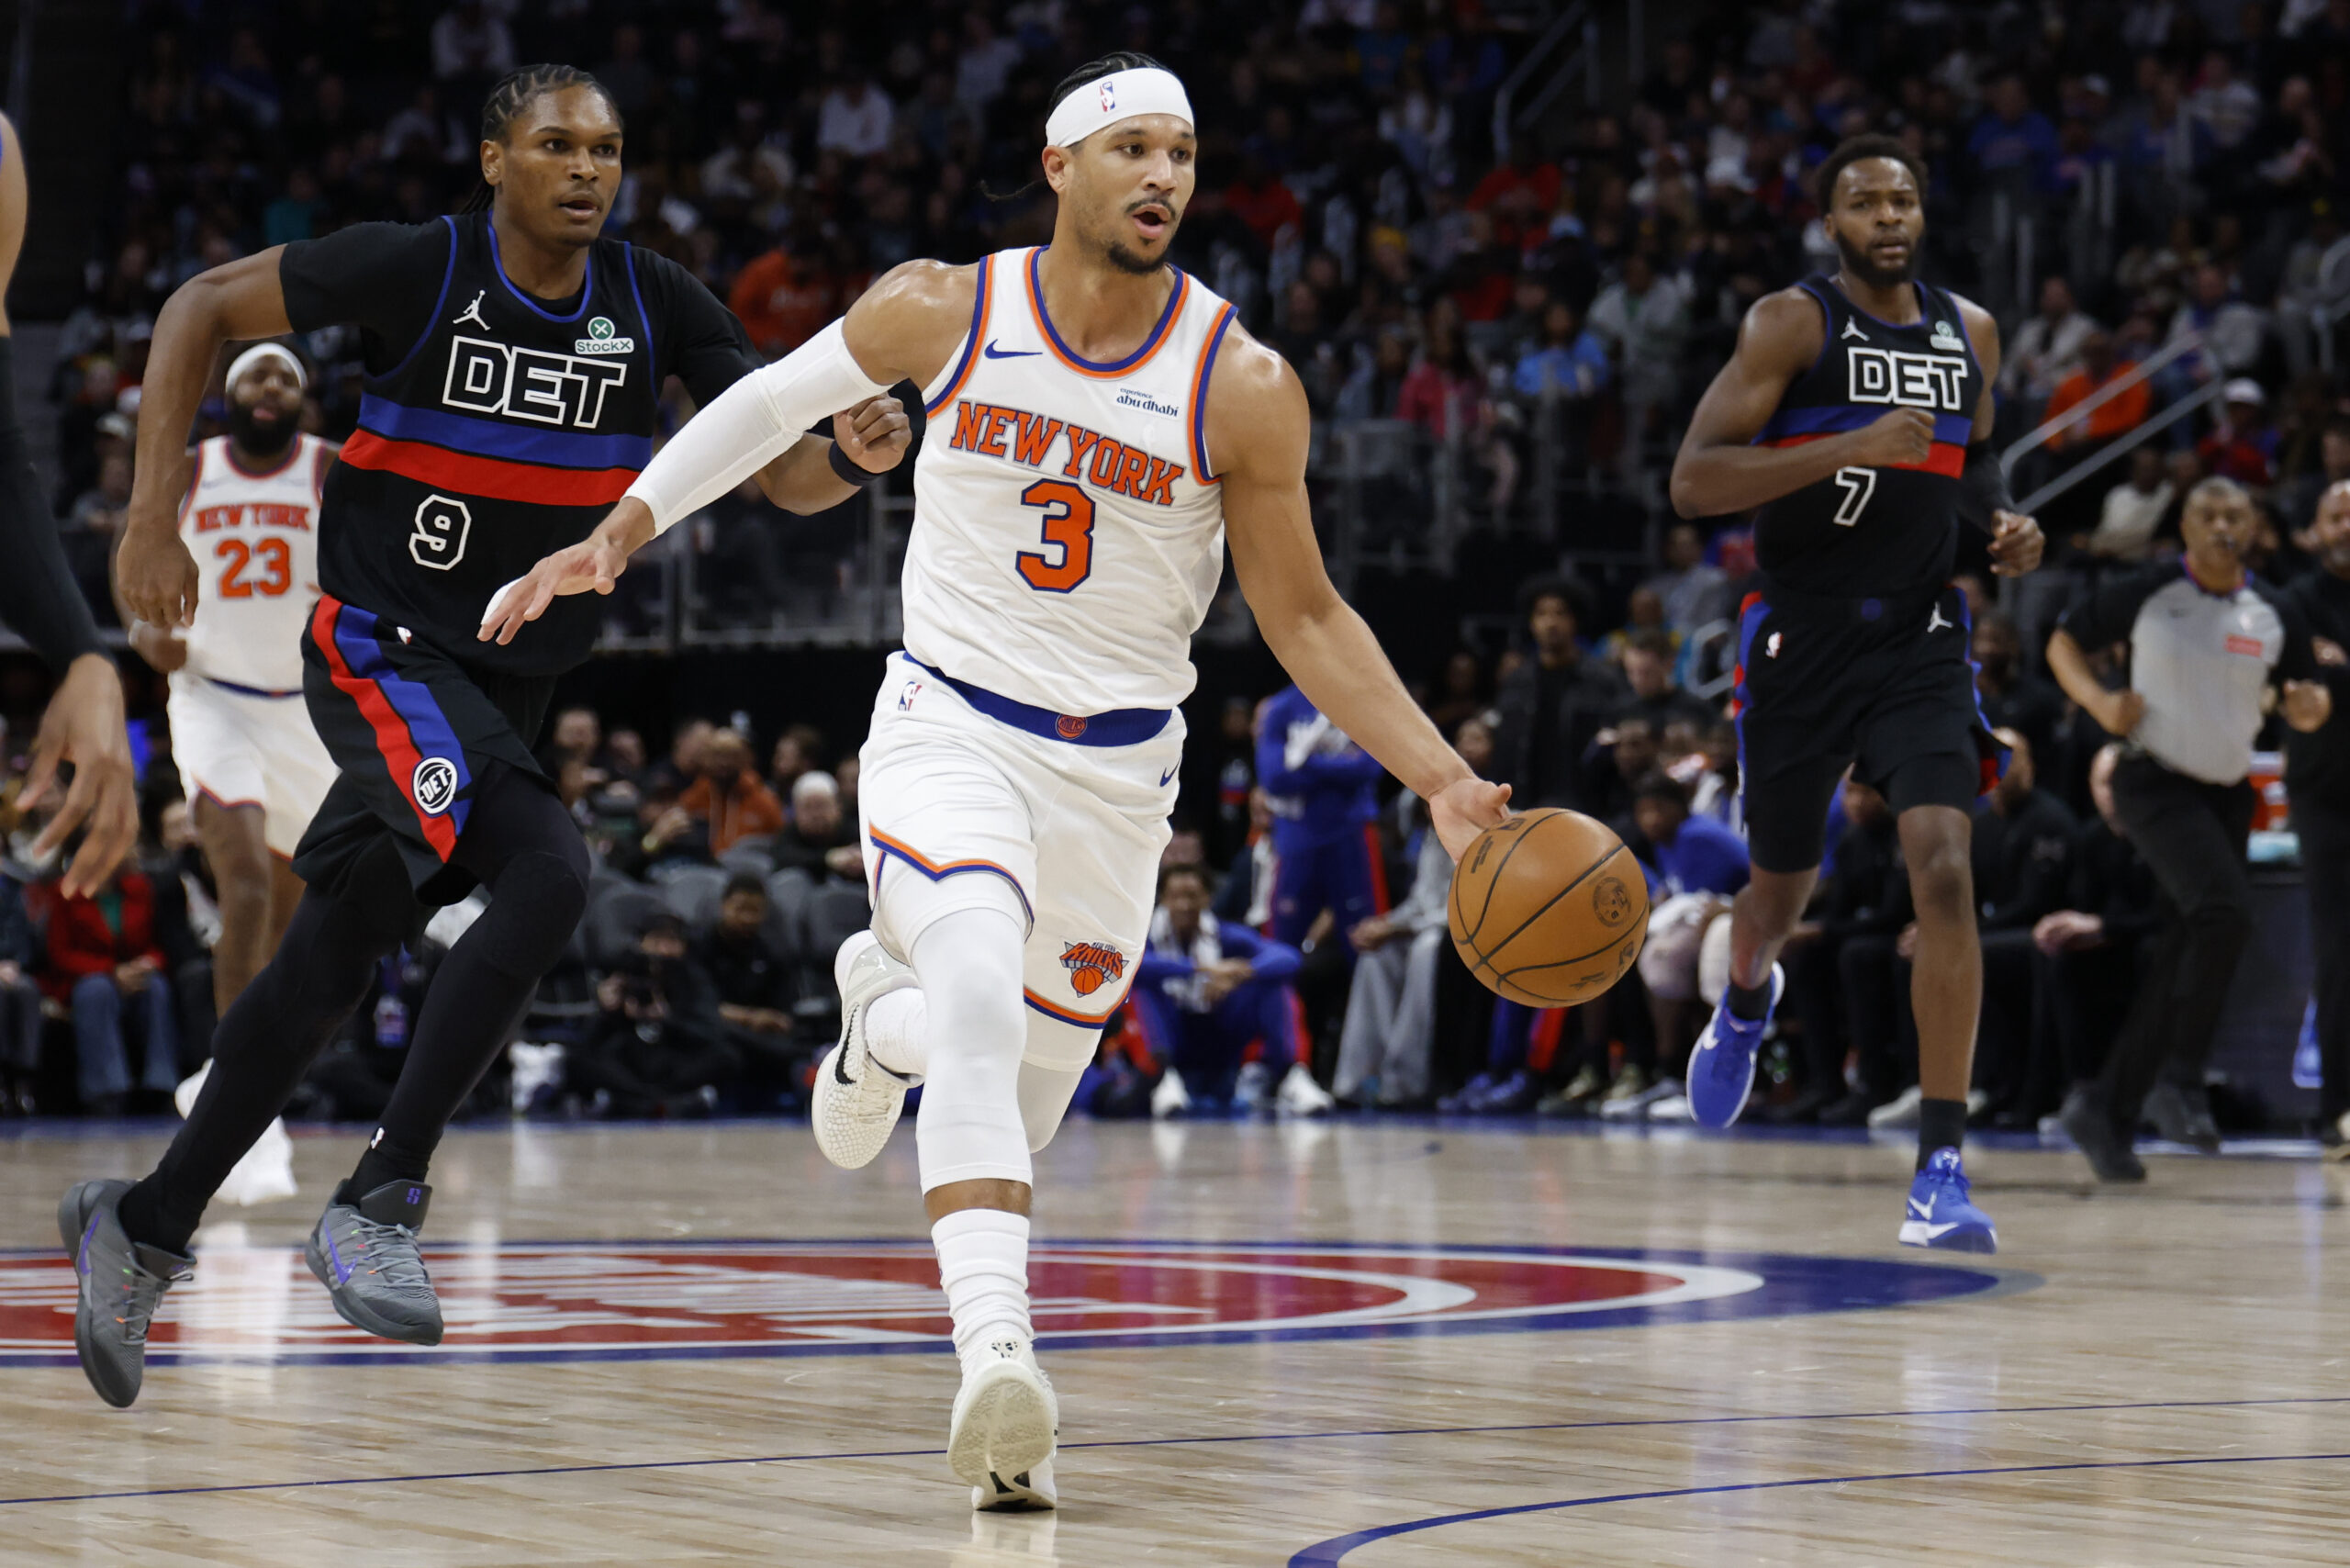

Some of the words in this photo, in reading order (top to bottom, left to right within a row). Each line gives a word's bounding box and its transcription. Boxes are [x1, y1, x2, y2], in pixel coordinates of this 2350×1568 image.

[576, 340, 632, 353] StockX
[442, 335, 627, 429] DET
[1116, 395, 1141, 409] abu
[1142, 399, 1180, 417] dhabi
[1120, 387, 1154, 399] experience
[1847, 346, 1968, 410] DET
[950, 399, 1063, 467] NEW
[1062, 423, 1185, 506] YORK
[195, 505, 244, 533] NEW
[250, 503, 310, 532] YORK
[1833, 465, 1876, 526] 7
[408, 494, 472, 570] 9
[1015, 478, 1096, 594] 3
[216, 537, 292, 599] 23
[420, 767, 449, 802] DET
[1059, 942, 1123, 979] KNICKS
